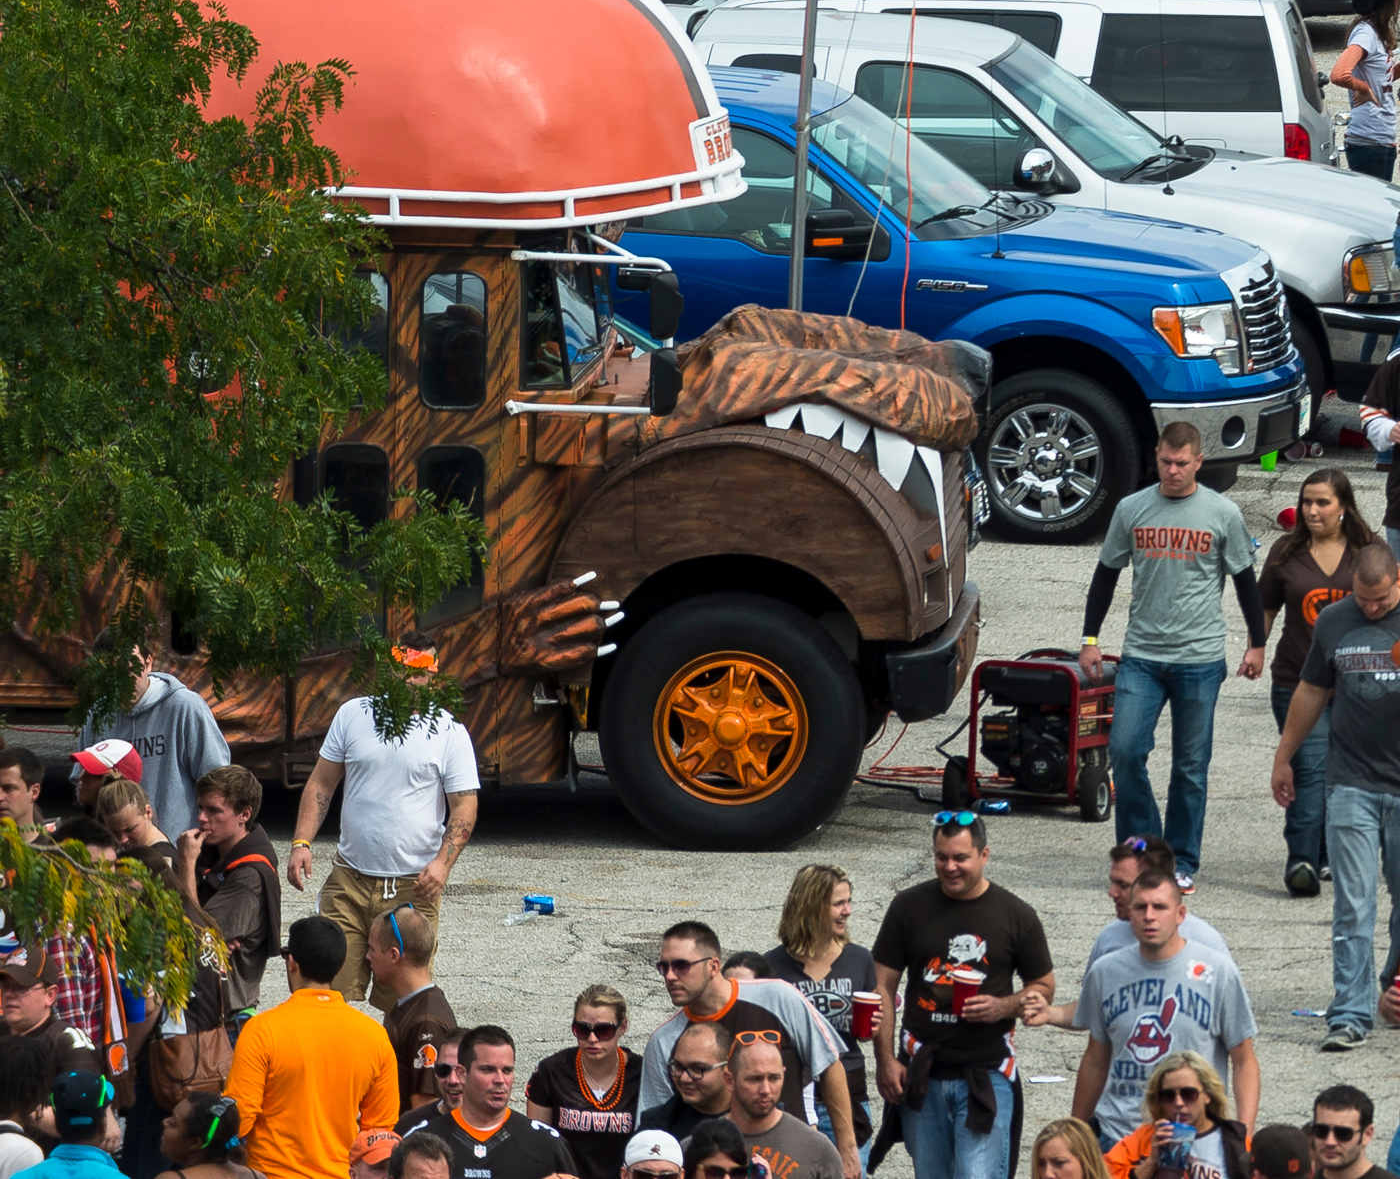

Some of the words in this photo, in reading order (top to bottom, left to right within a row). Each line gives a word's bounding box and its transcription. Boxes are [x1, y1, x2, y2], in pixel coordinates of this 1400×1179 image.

[1132, 526, 1213, 556] BROWNS
[1102, 977, 1212, 1032] CLEVELAND
[559, 1106, 633, 1134] BROWNS
[464, 1167, 493, 1179] BROWNS
